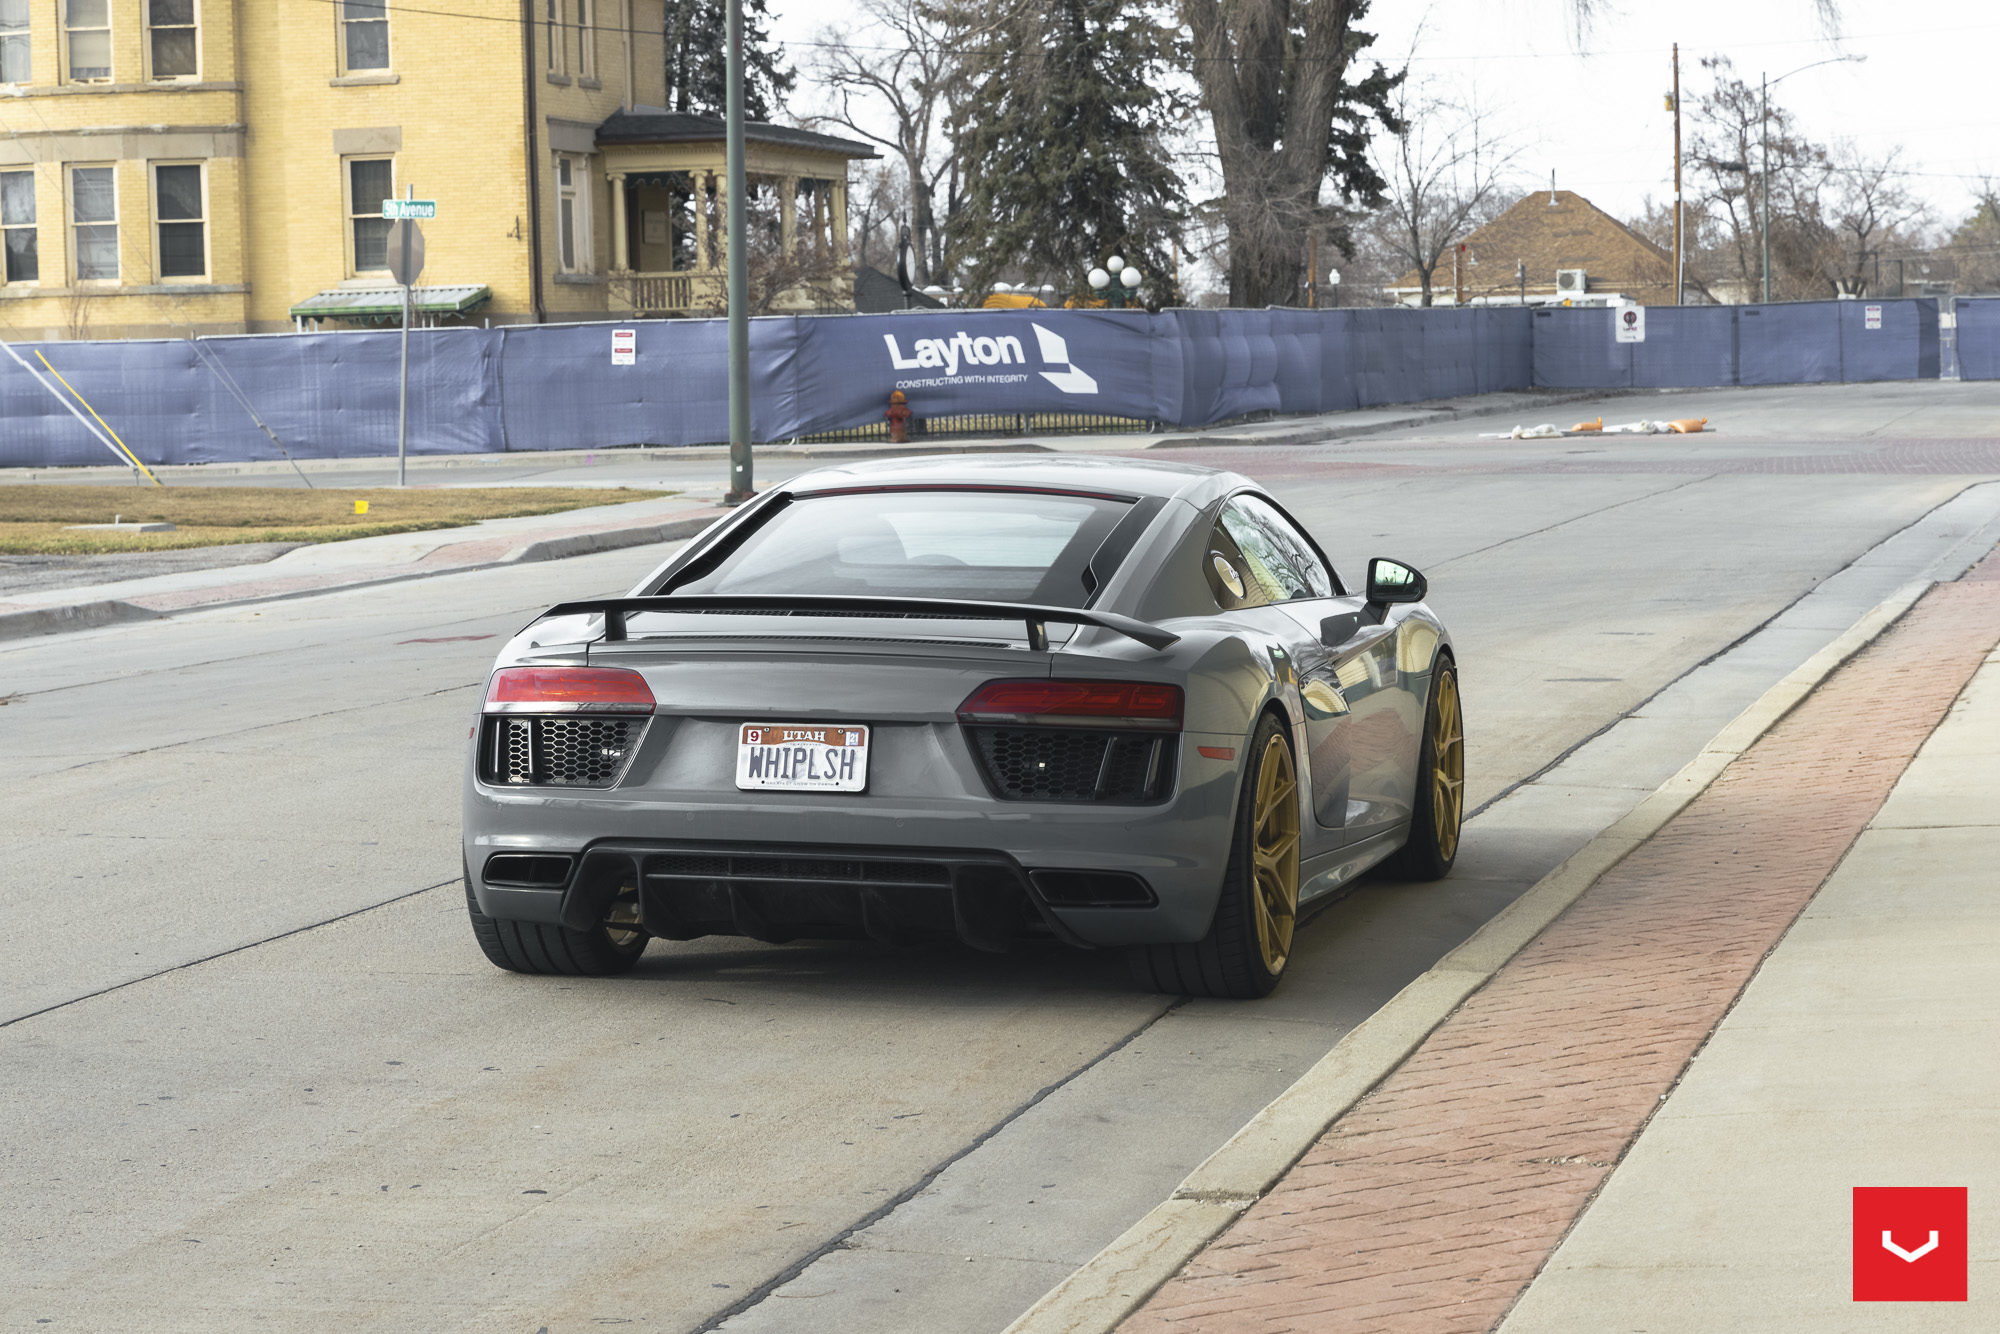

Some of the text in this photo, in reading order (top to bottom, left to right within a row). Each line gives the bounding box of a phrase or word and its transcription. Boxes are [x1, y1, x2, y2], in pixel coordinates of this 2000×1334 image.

[400, 201, 434, 217] Avenue
[883, 331, 1026, 376] Layton
[896, 374, 1028, 390] CONSTRUCTING WITH INTEGRITY
[750, 731, 760, 742] 9
[782, 730, 826, 742] UTAH
[850, 732, 859, 744] 21
[748, 746, 856, 780] WHIPLSH
